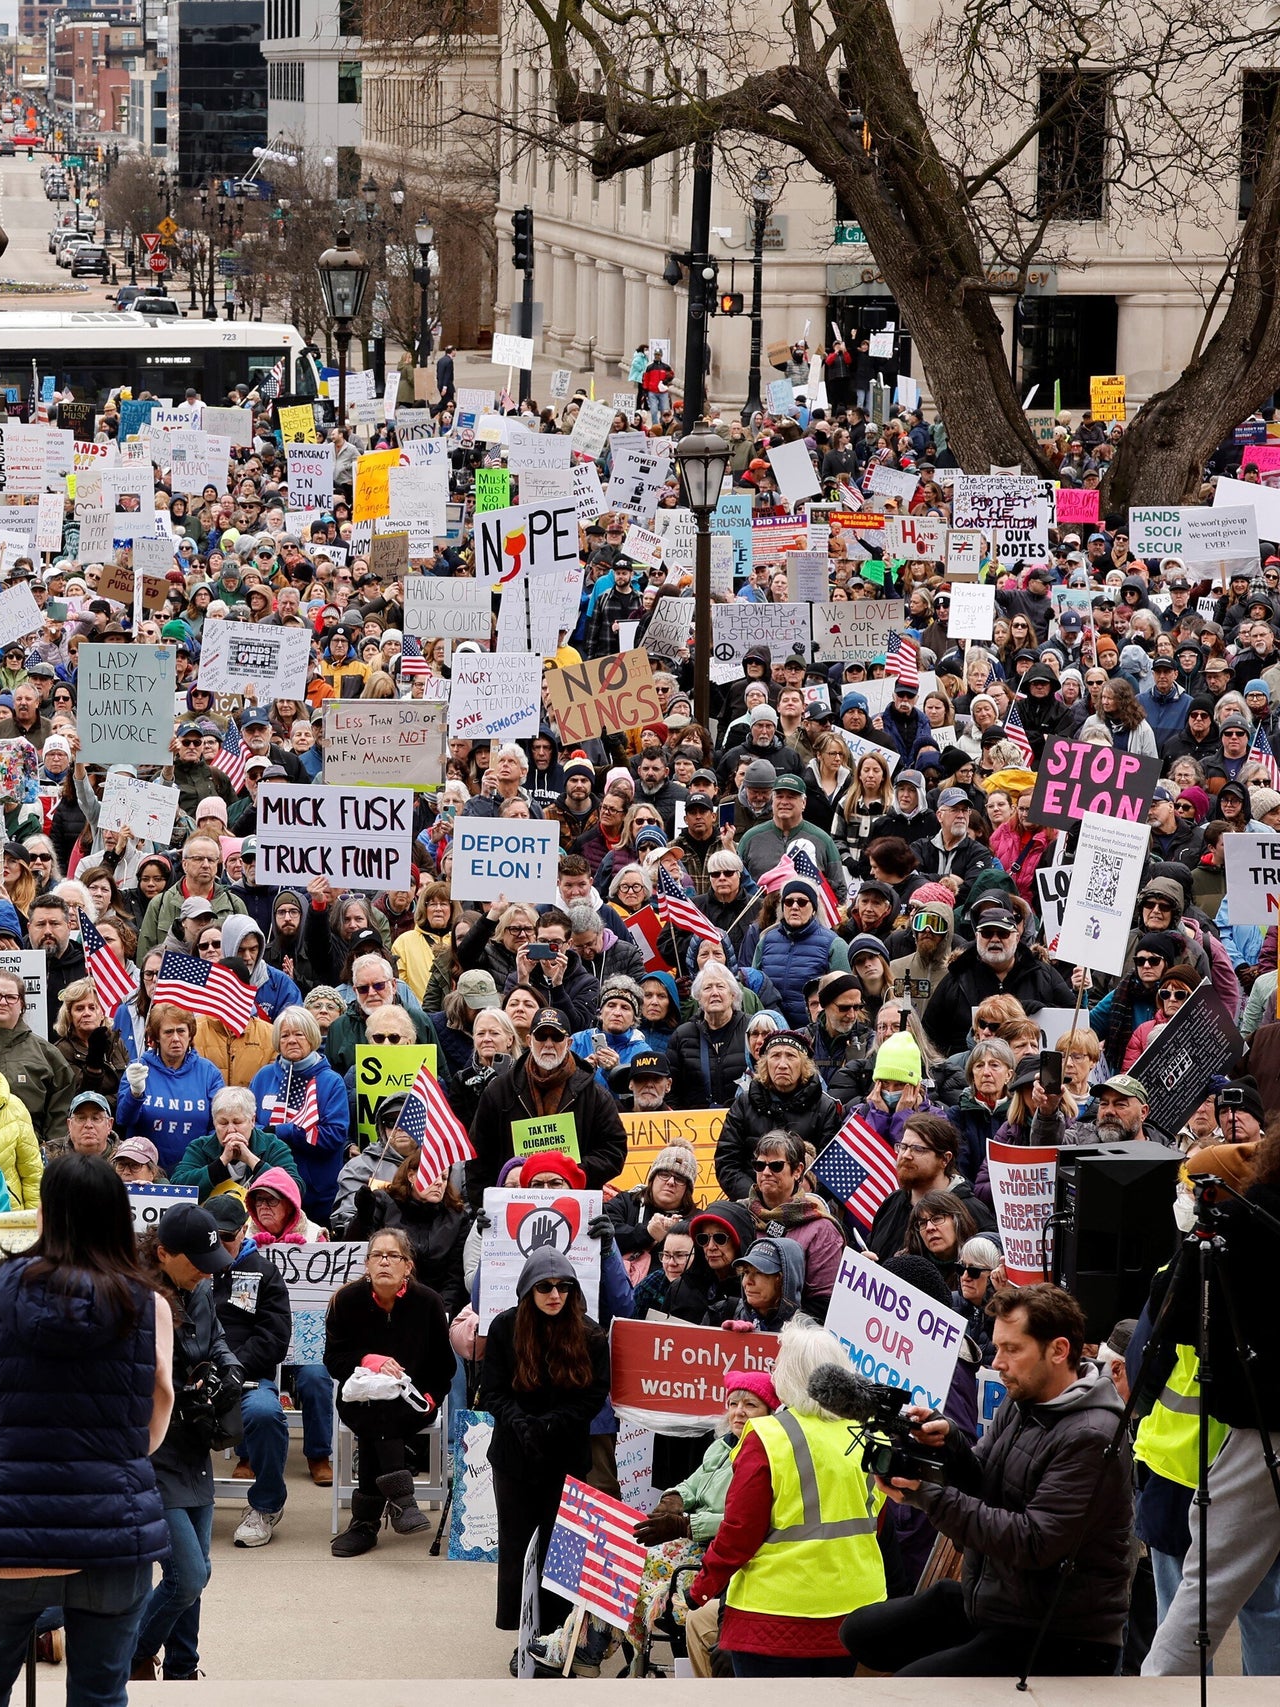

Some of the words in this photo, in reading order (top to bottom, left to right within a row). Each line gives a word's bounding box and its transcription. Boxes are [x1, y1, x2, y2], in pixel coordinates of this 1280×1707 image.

[150, 258, 167, 266] STOP
[221, 333, 237, 341] 723
[288, 449, 329, 459] DEMOCRACY
[295, 477, 313, 489] IN
[289, 492, 332, 508] SILENCE
[1200, 518, 1220, 526] won't
[1221, 517, 1237, 527] give
[1201, 530, 1221, 538] won't
[1222, 529, 1238, 538] give
[1239, 527, 1246, 535] in
[1205, 541, 1225, 549] EVER
[406, 579, 444, 600] HANDS
[406, 609, 435, 630] OUR
[443, 610, 490, 631] COURTS
[97, 650, 137, 668] LADY
[88, 673, 158, 692] LIBERTY
[561, 654, 627, 702] NO
[88, 699, 137, 717] WANTS
[142, 701, 153, 716] A
[555, 684, 659, 743] KINGS
[91, 723, 157, 744] DIVORCE
[1046, 740, 1141, 788] STOP
[1042, 780, 1143, 822] ELON
[262, 797, 326, 827] MUCK
[340, 796, 406, 830] FUSK
[460, 834, 550, 854] DEPORT
[260, 844, 333, 875] TRUCK
[342, 845, 399, 880] FUMP
[470, 859, 529, 879] ELON
[636, 1057, 658, 1066] NAVY
[154, 1119, 192, 1134] OFF
[528, 1125, 542, 1136] TAX
[542, 1123, 557, 1133] THE
[523, 1134, 565, 1149] OLIGARCHS
[1007, 1168, 1049, 1182] VALUE
[1005, 1236, 1032, 1253] FUND
[568, 1254, 594, 1262] Security
[838, 1260, 911, 1321] HANDS
[917, 1308, 960, 1348] OFF
[865, 1316, 914, 1365] OUR
